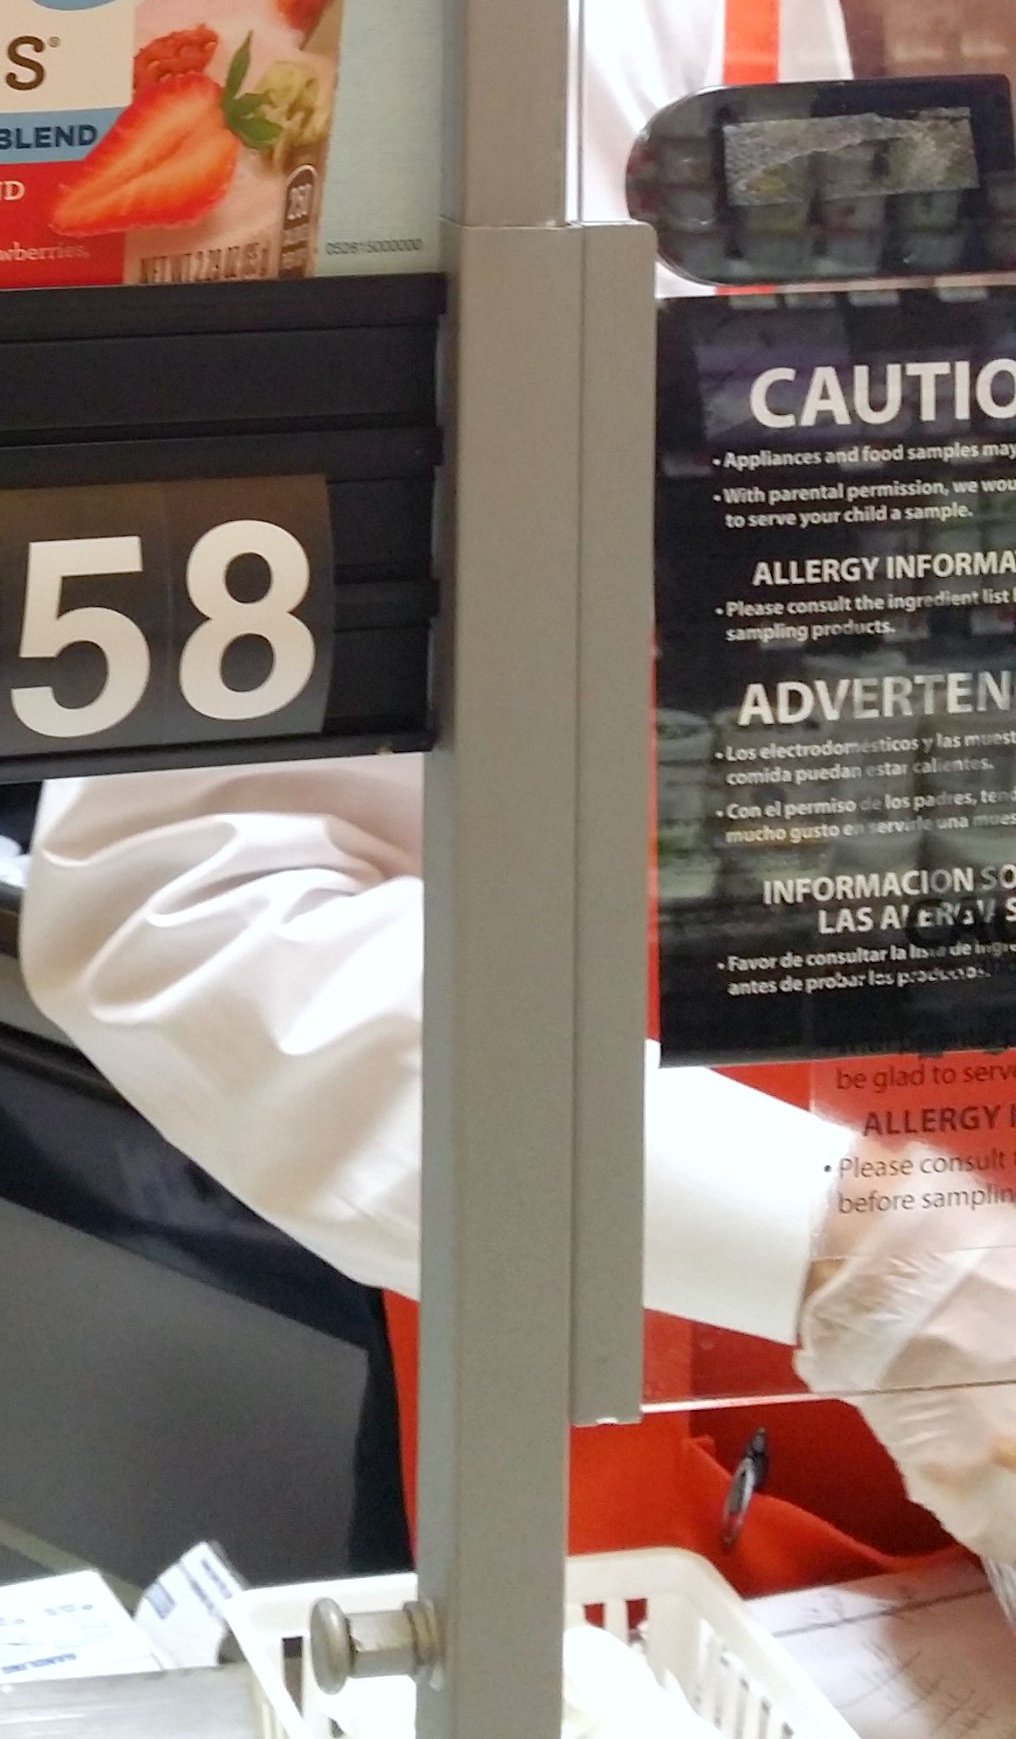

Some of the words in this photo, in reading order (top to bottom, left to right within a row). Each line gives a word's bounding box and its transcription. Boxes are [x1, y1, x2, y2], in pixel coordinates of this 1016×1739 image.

[723, 450, 822, 472] Appliances
[825, 448, 859, 464] and
[862, 445, 904, 463] food
[907, 441, 979, 462] samples
[983, 443, 1016, 459] may
[723, 487, 765, 505] With
[769, 484, 844, 507] parental
[847, 479, 950, 506] permission,
[953, 481, 978, 494] we
[725, 513, 745, 529] to
[748, 512, 796, 528] serve
[799, 509, 839, 529] your
[844, 505, 887, 524] child
[890, 508, 902, 521] a
[905, 502, 973, 523] sample.
[752, 557, 879, 587] ALLERGY
[726, 600, 784, 617] Please
[787, 596, 851, 615] consult
[854, 595, 883, 612] the
[887, 590, 980, 613] ingredient
[982, 587, 1010, 605] list
[725, 623, 808, 644] sampling
[812, 619, 896, 640] products.
[726, 746, 757, 762] Los
[922, 737, 933, 754] y
[936, 732, 961, 749] las
[726, 766, 793, 786] comida
[795, 763, 862, 786] puedan
[865, 762, 908, 778] estar
[726, 803, 762, 820] Con
[765, 800, 782, 817] el
[784, 797, 857, 821] permiso
[858, 795, 882, 811] de
[885, 793, 911, 810] los
[726, 825, 787, 844] mucho
[789, 823, 840, 844] gusto
[936, 816, 969, 830] una
[762, 867, 974, 905] INFORMACION
[818, 906, 874, 935] LAS
[727, 955, 777, 972] Favor
[779, 951, 803, 968] de
[805, 946, 888, 967] consultar
[890, 943, 907, 960] la
[949, 939, 972, 956] de
[727, 979, 778, 997] antes
[779, 975, 803, 992] de
[805, 971, 867, 995] probar
[869, 968, 895, 986] los
[836, 1067, 866, 1090] be
[873, 1063, 925, 1093] glad
[932, 1066, 956, 1084] to
[864, 1105, 1001, 1137] ALLERGY
[839, 1156, 914, 1179] Please
[920, 1148, 1005, 1174] consult
[838, 1190, 915, 1214] before
